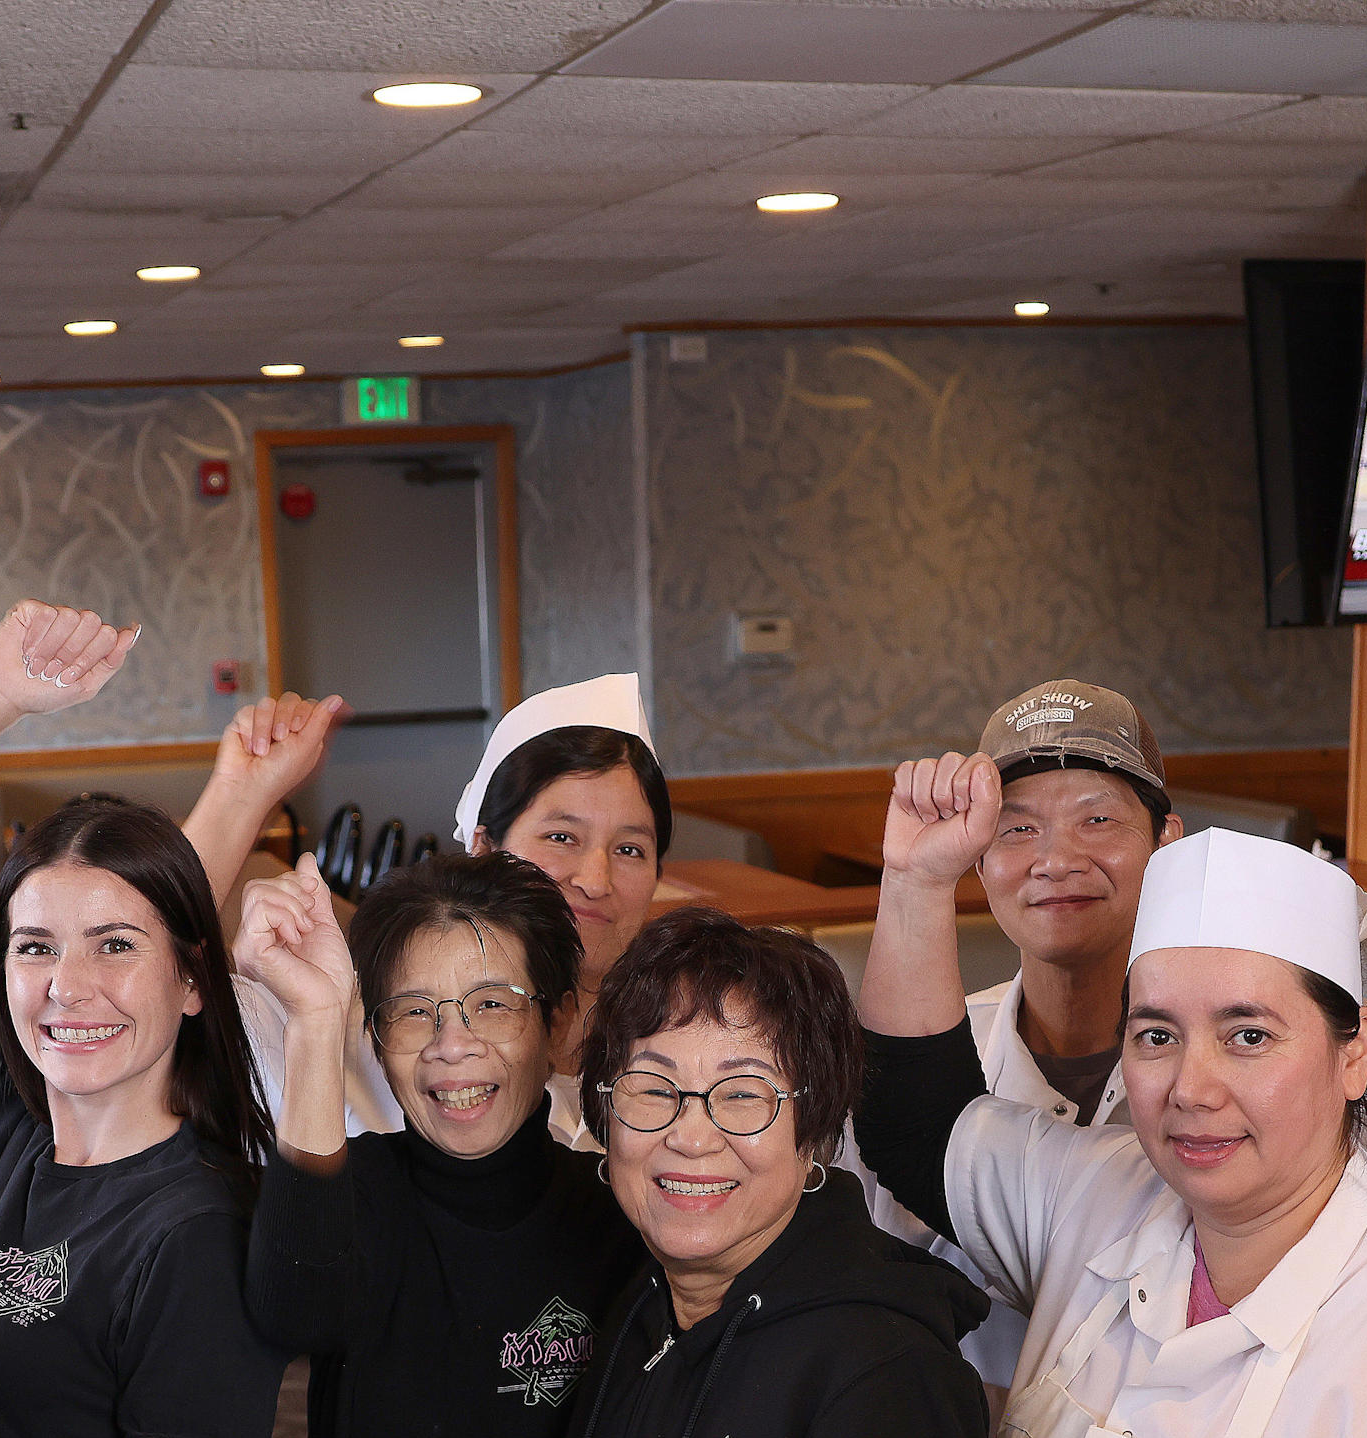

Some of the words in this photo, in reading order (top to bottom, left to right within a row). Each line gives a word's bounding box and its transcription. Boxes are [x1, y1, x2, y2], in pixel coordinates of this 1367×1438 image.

[358, 377, 409, 420] EXIT
[1005, 698, 1037, 726] SHIT
[1041, 692, 1093, 711] SHOW
[1018, 710, 1072, 727] SUPERVISOR
[501, 1328, 593, 1369] MAUI
